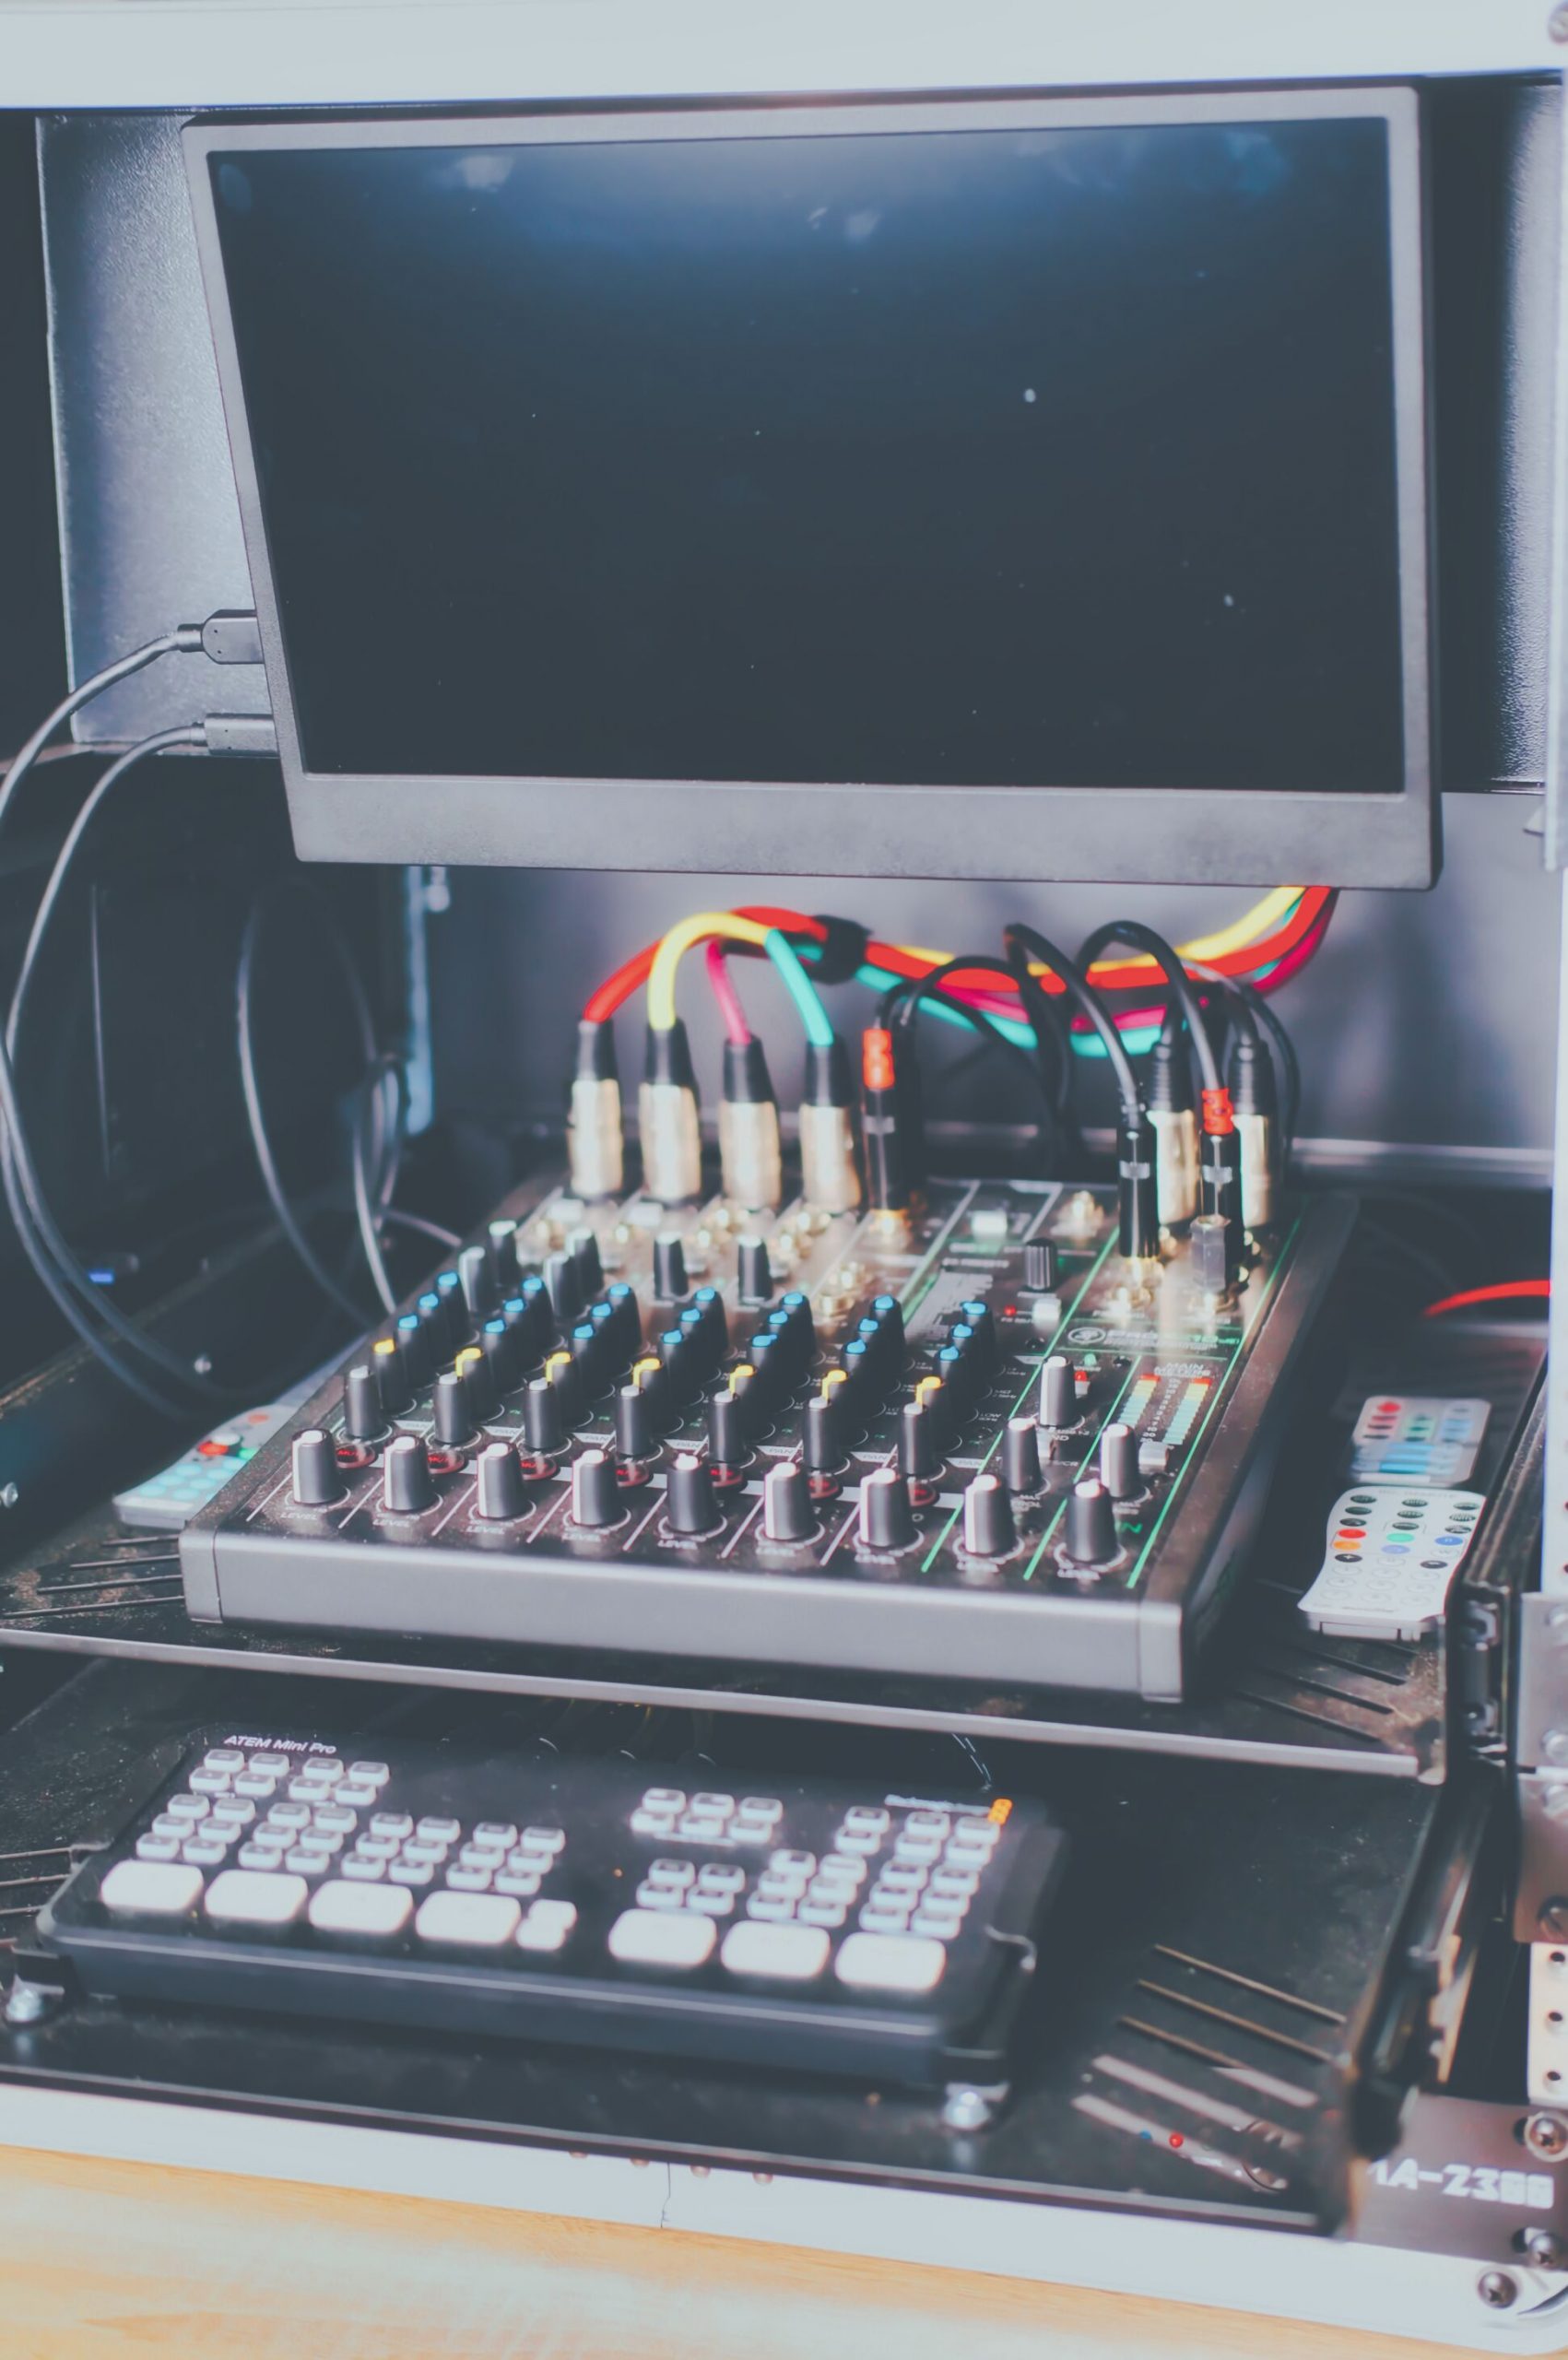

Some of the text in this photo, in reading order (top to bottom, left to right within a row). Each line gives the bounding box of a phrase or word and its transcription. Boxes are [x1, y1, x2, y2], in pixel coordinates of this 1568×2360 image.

[280, 1512, 318, 1520] LEVEL
[371, 1518, 410, 1528] LEVEL
[466, 1525, 504, 1534] LEVEL
[224, 1735, 337, 1754] ATEM Mini Pro
